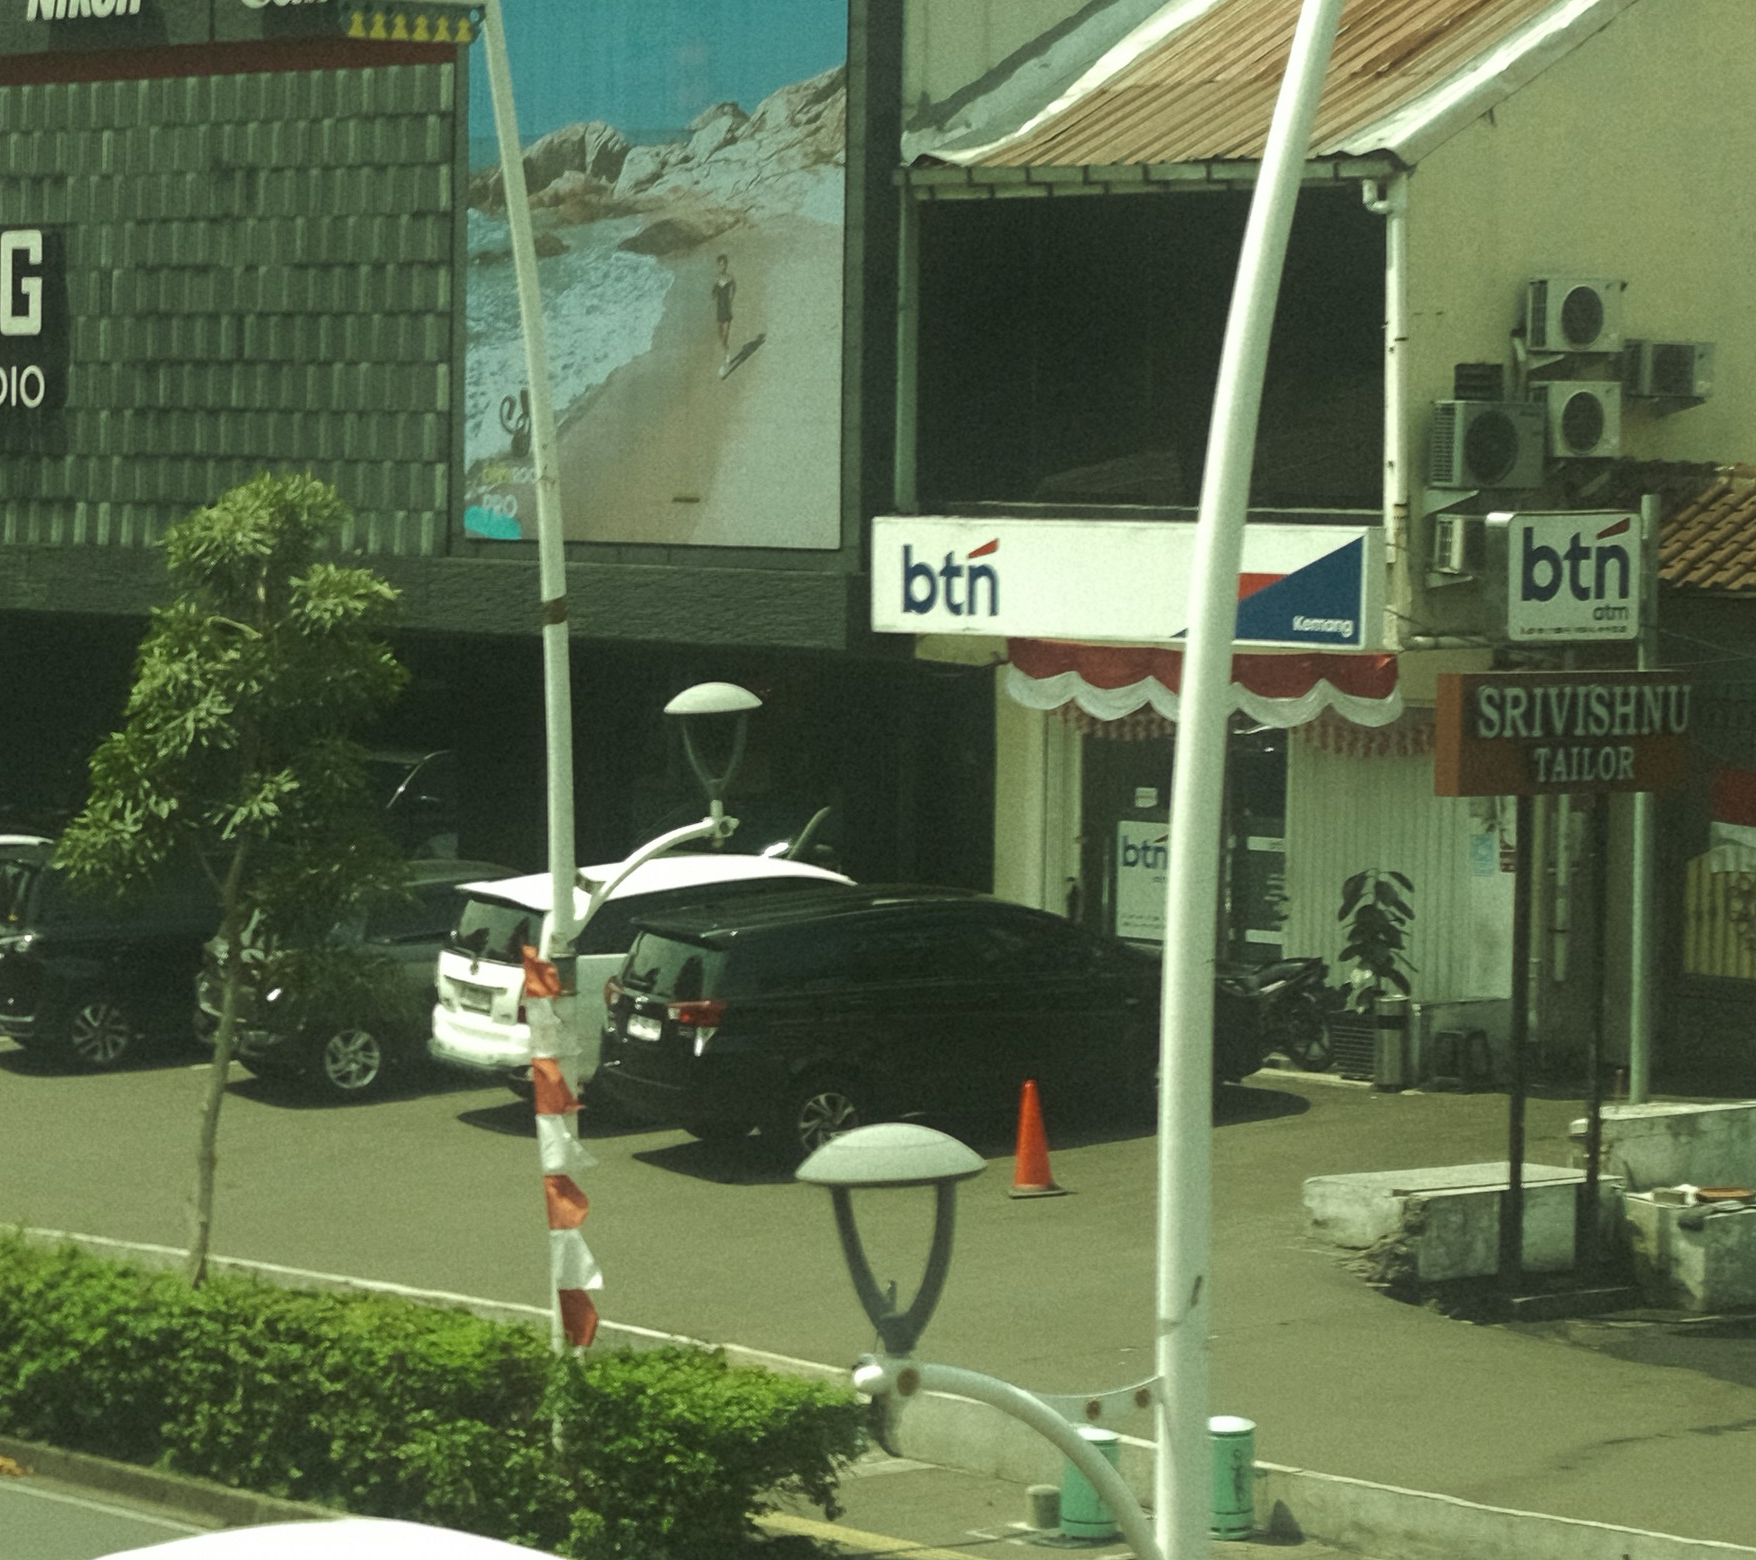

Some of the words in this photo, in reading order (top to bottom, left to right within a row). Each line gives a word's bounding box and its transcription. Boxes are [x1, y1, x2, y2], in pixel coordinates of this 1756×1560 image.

[902, 538, 1000, 616] btn
[1521, 517, 1631, 602] btn
[1476, 684, 1693, 739] SRIVISHNU
[1533, 746, 1637, 783] TAILOR
